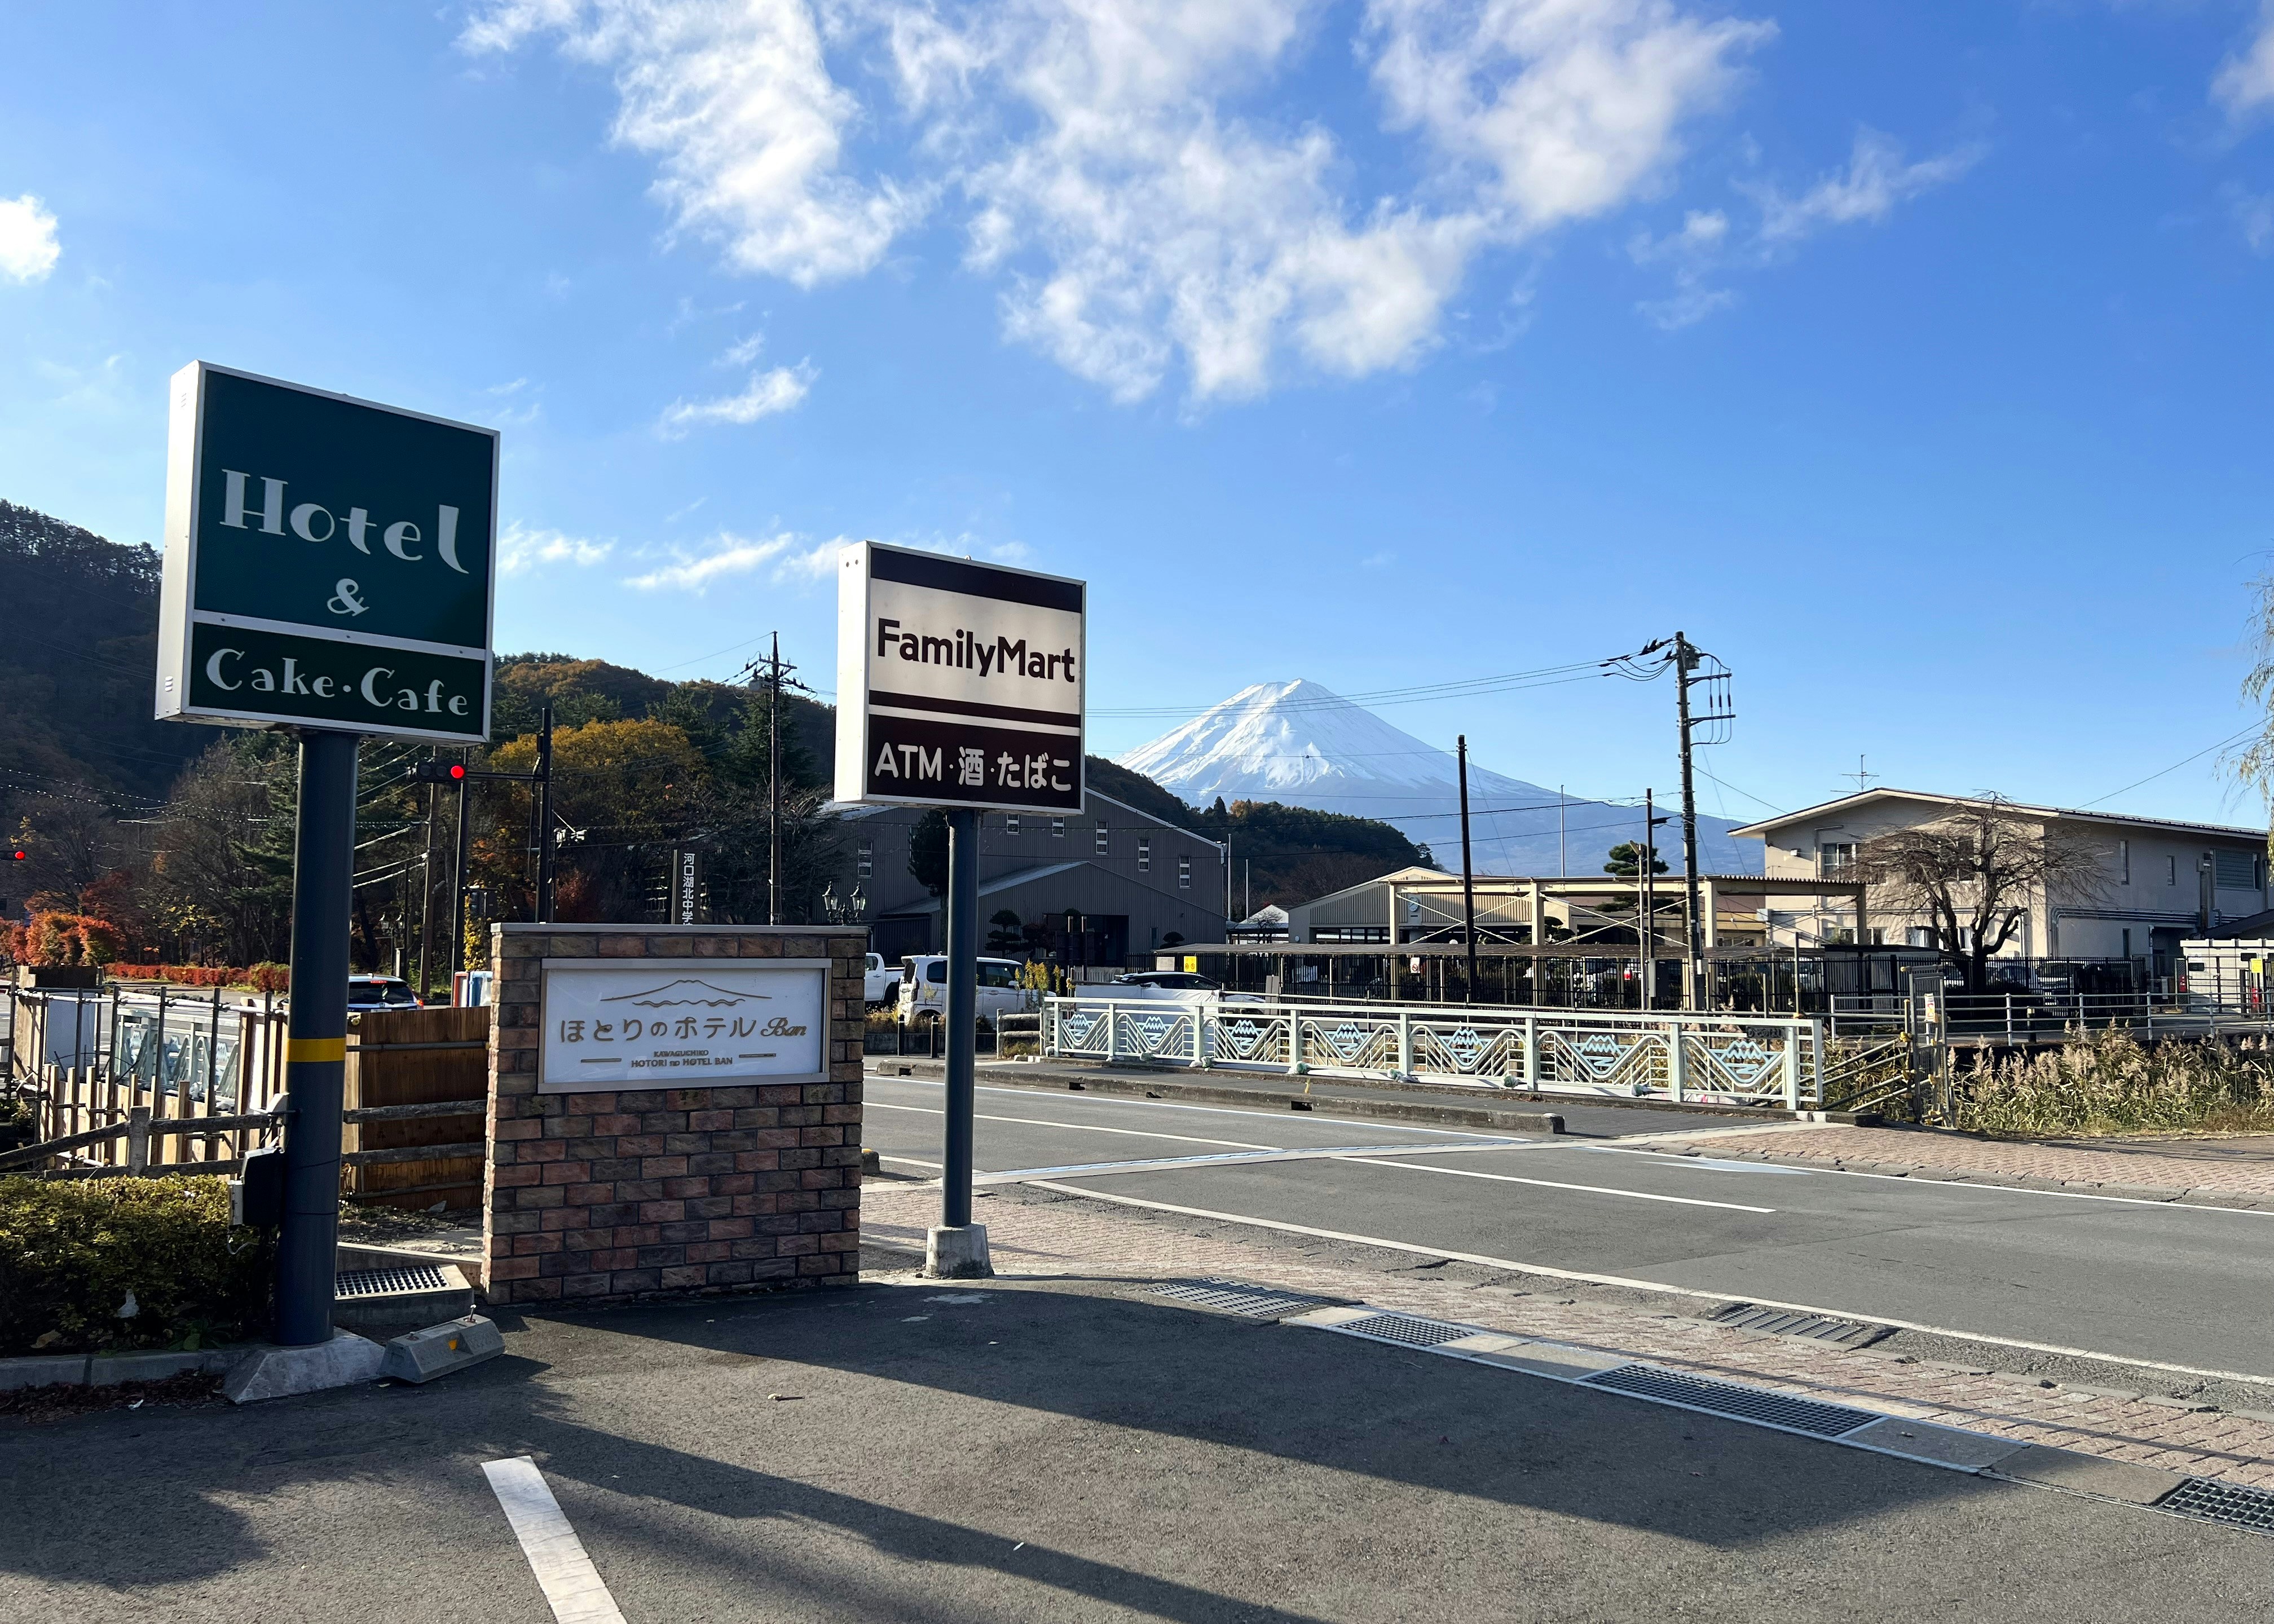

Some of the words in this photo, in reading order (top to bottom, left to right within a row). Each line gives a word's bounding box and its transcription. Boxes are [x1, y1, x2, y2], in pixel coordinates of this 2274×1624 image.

[219, 469, 469, 574] Hotel
[327, 578, 369, 616] &
[878, 617, 1075, 682] FamilyMart
[682, 853, 695, 925] 河口湖北中学
[561, 1017, 757, 1043] ほとりのホテル
[760, 1017, 807, 1037] Ban
